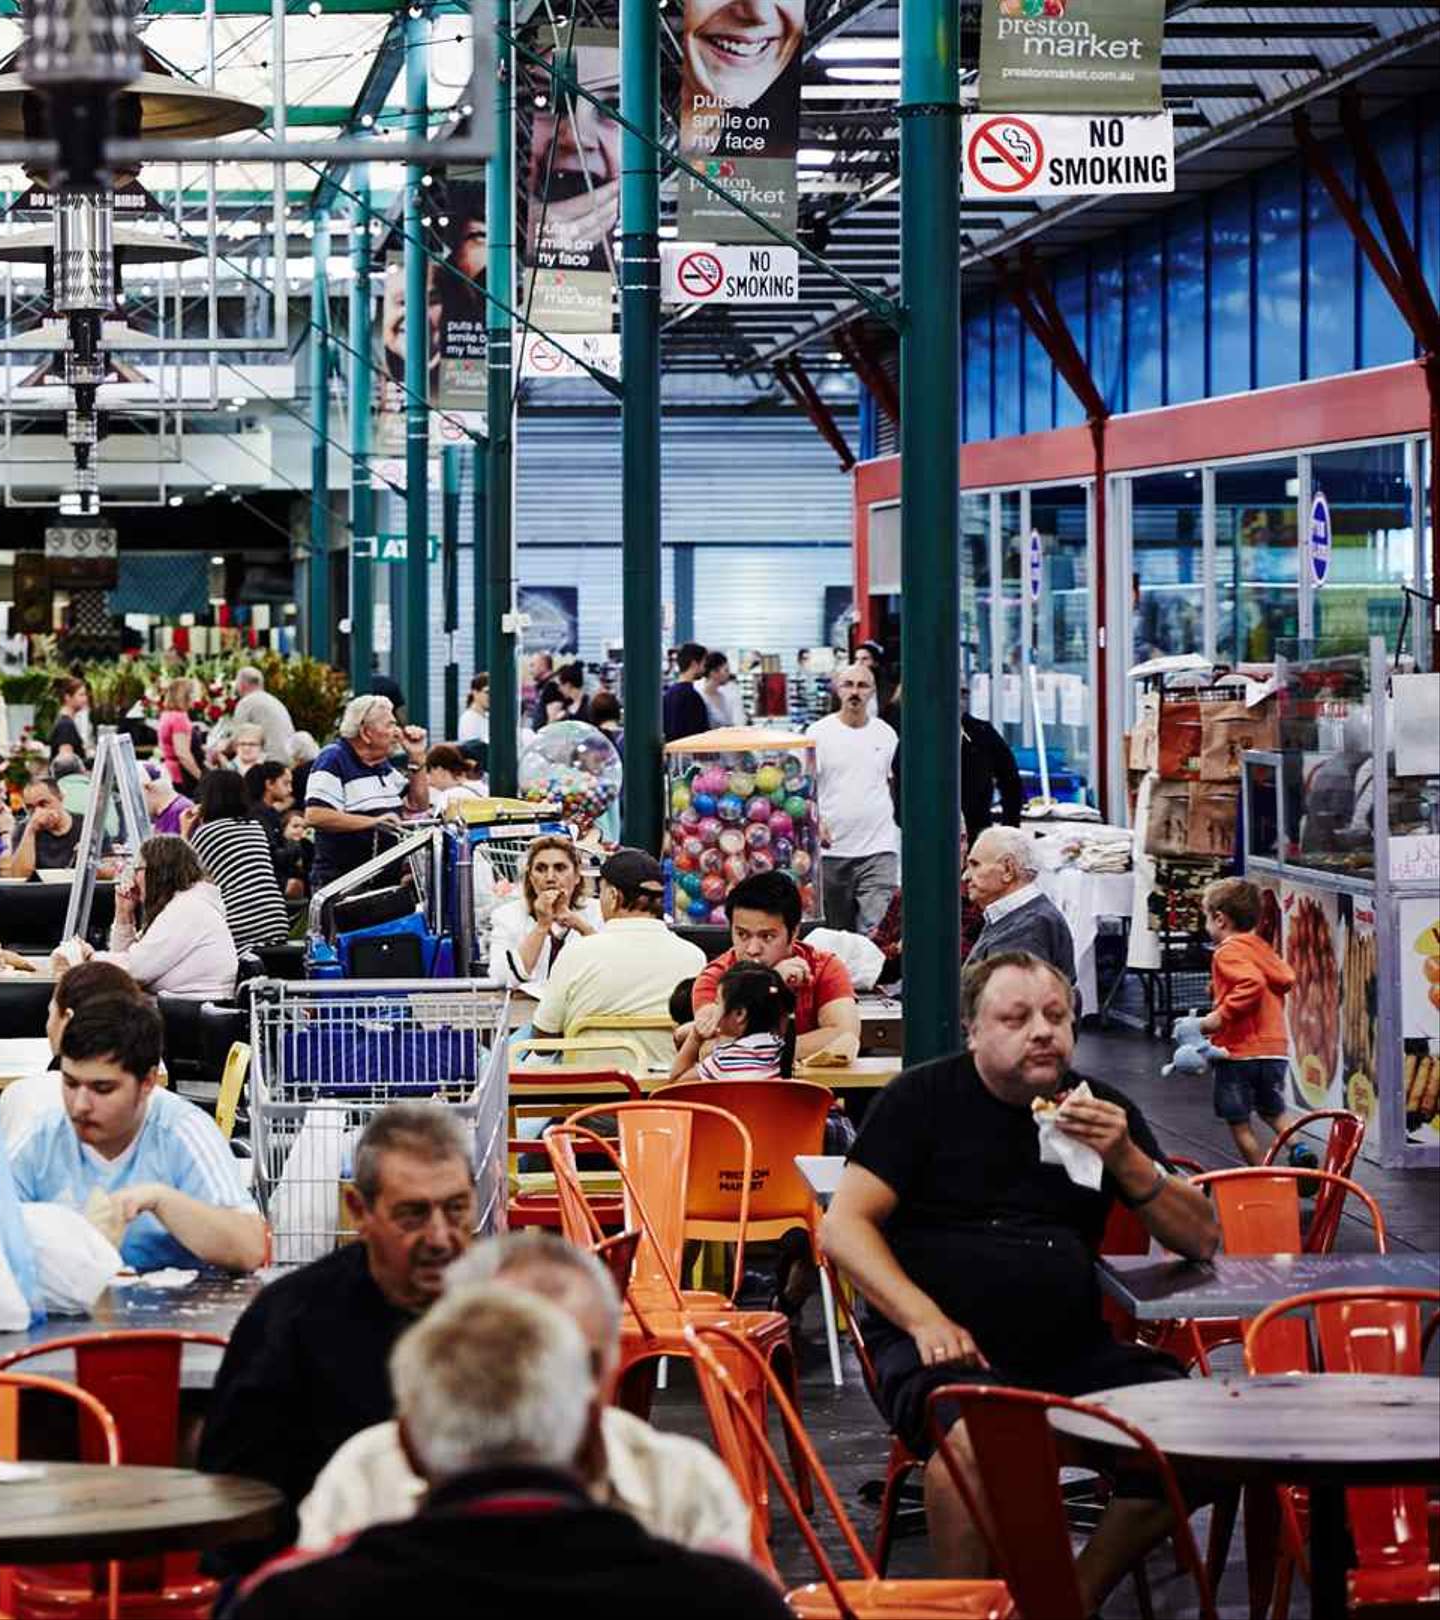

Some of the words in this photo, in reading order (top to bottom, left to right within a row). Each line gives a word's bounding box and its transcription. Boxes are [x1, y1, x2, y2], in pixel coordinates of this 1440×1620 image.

[997, 18, 1089, 39] preston
[1024, 34, 1143, 59] market
[1002, 67, 1136, 82] prestonmarket.com.au
[693, 114, 741, 130] smile
[745, 116, 770, 130] on
[691, 135, 720, 153] my
[725, 133, 766, 150] face
[1090, 119, 1123, 148] NO
[1049, 155, 1167, 186] SMOKING
[114, 194, 146, 207] BIRDS
[559, 250, 590, 266] face
[750, 252, 770, 271] NO
[726, 276, 794, 297] SMOKING
